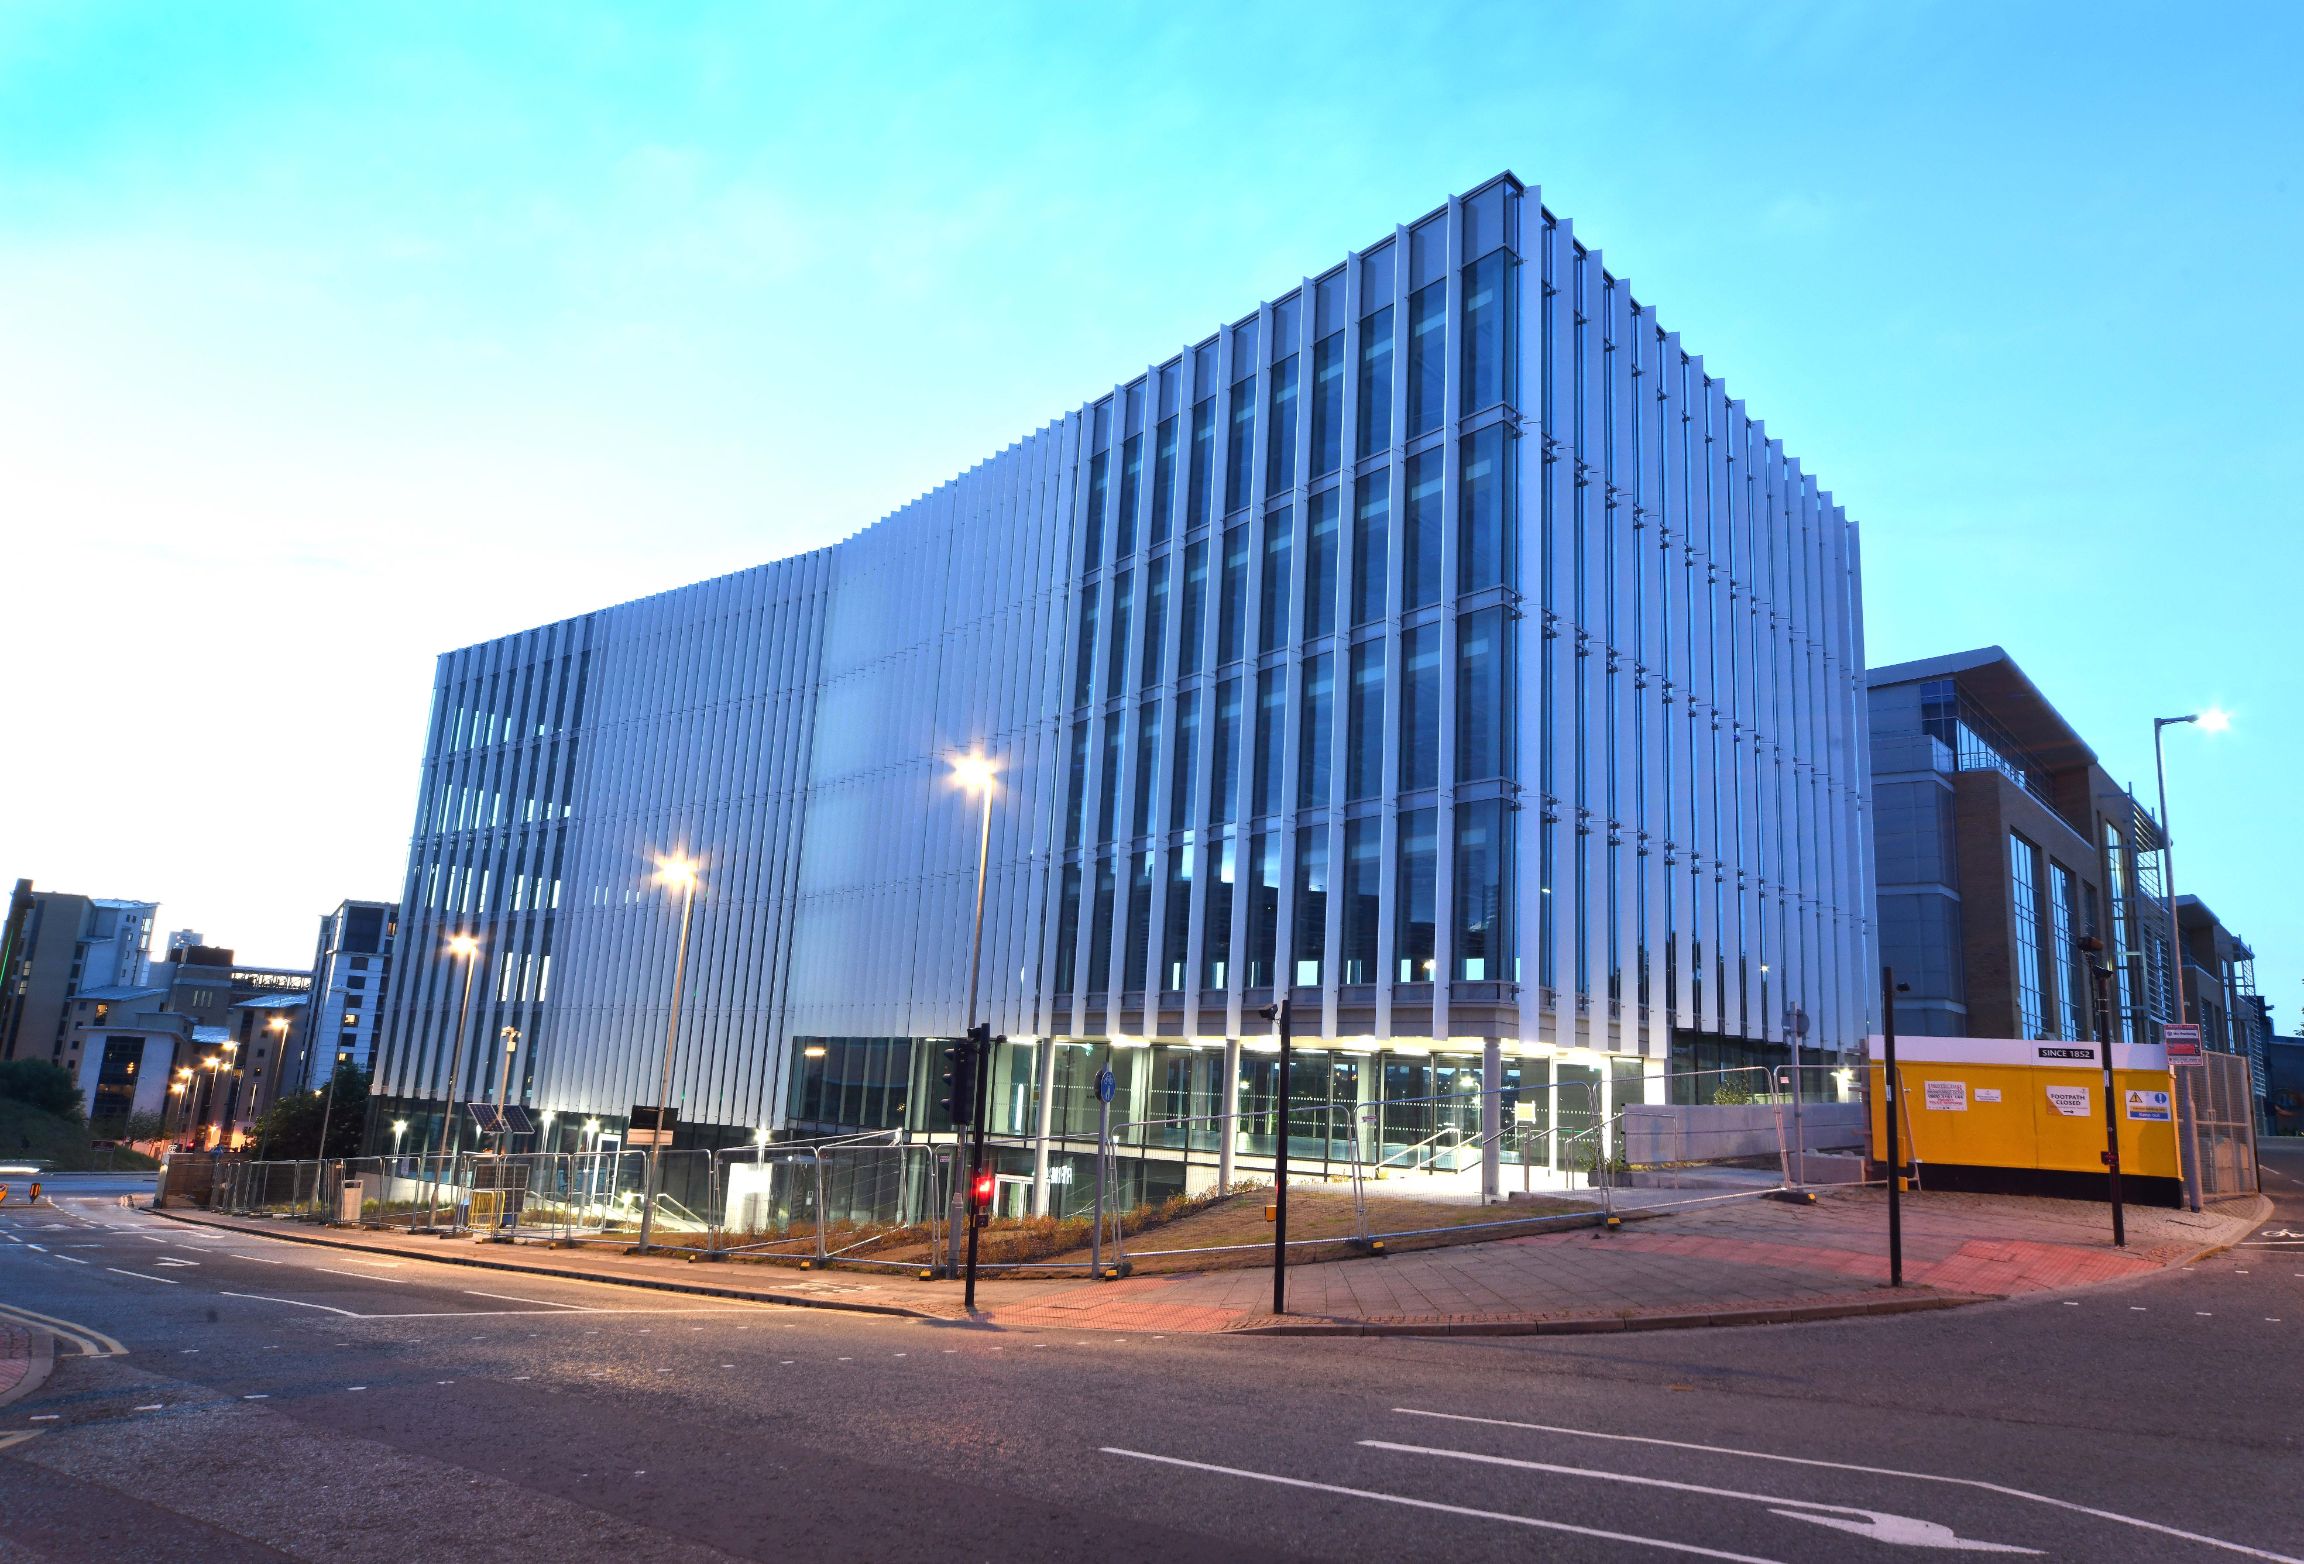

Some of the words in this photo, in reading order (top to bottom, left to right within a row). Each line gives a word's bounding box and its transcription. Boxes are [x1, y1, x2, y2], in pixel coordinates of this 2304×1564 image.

[2042, 1049, 2067, 1057] SINCE
[2069, 1050, 2090, 1058] 1852
[2050, 1093, 2086, 1101] FOOTPATH
